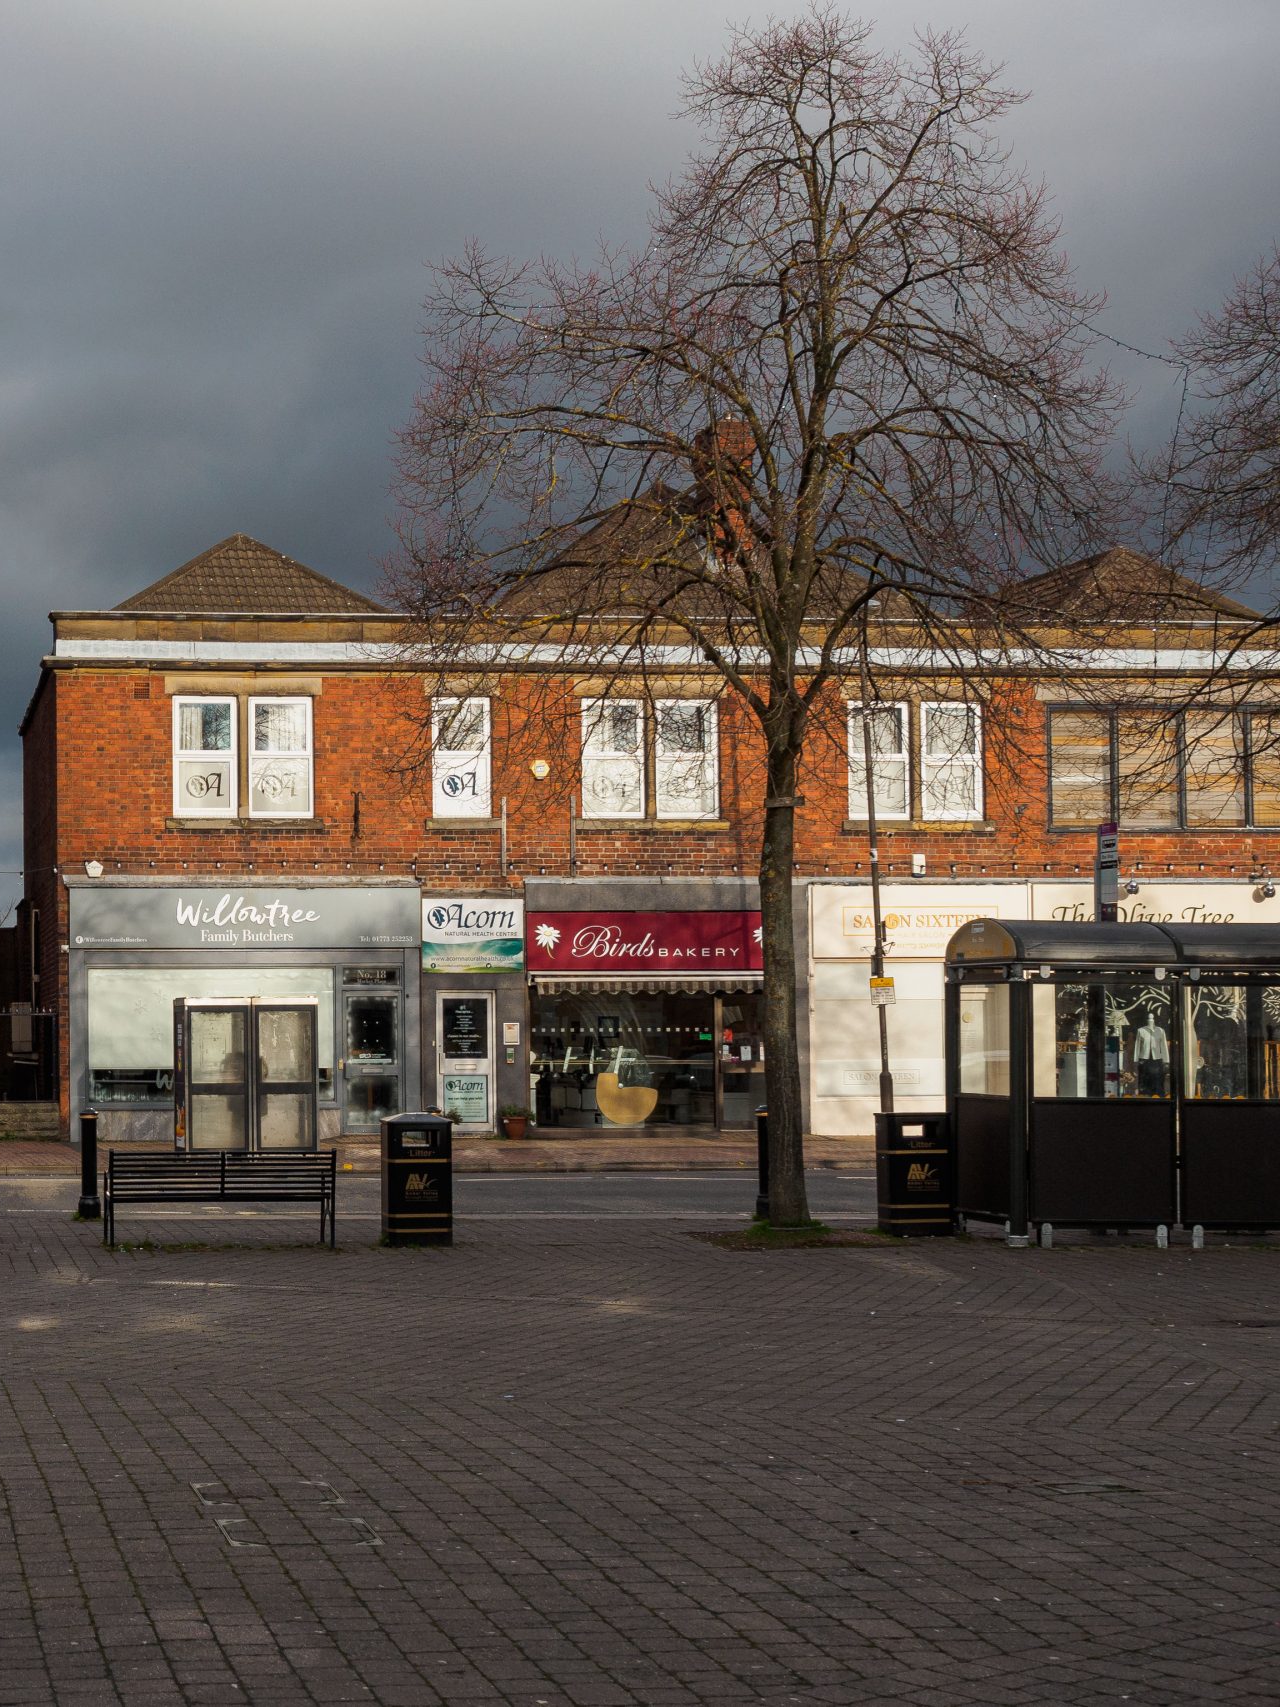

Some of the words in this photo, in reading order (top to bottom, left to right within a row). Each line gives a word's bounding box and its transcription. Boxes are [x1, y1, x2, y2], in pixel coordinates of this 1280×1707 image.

[176, 893, 320, 927] Willowtree
[446, 903, 516, 928] Acorn
[1181, 904, 1235, 923] Tree
[853, 913, 911, 929] SAON
[201, 929, 239, 945] Family
[242, 929, 294, 942] Butchers
[571, 925, 655, 958] Birds
[658, 948, 740, 957] BAKERY
[357, 969, 373, 978] No.
[376, 969, 387, 978] 18
[455, 1079, 484, 1091] Acorn
